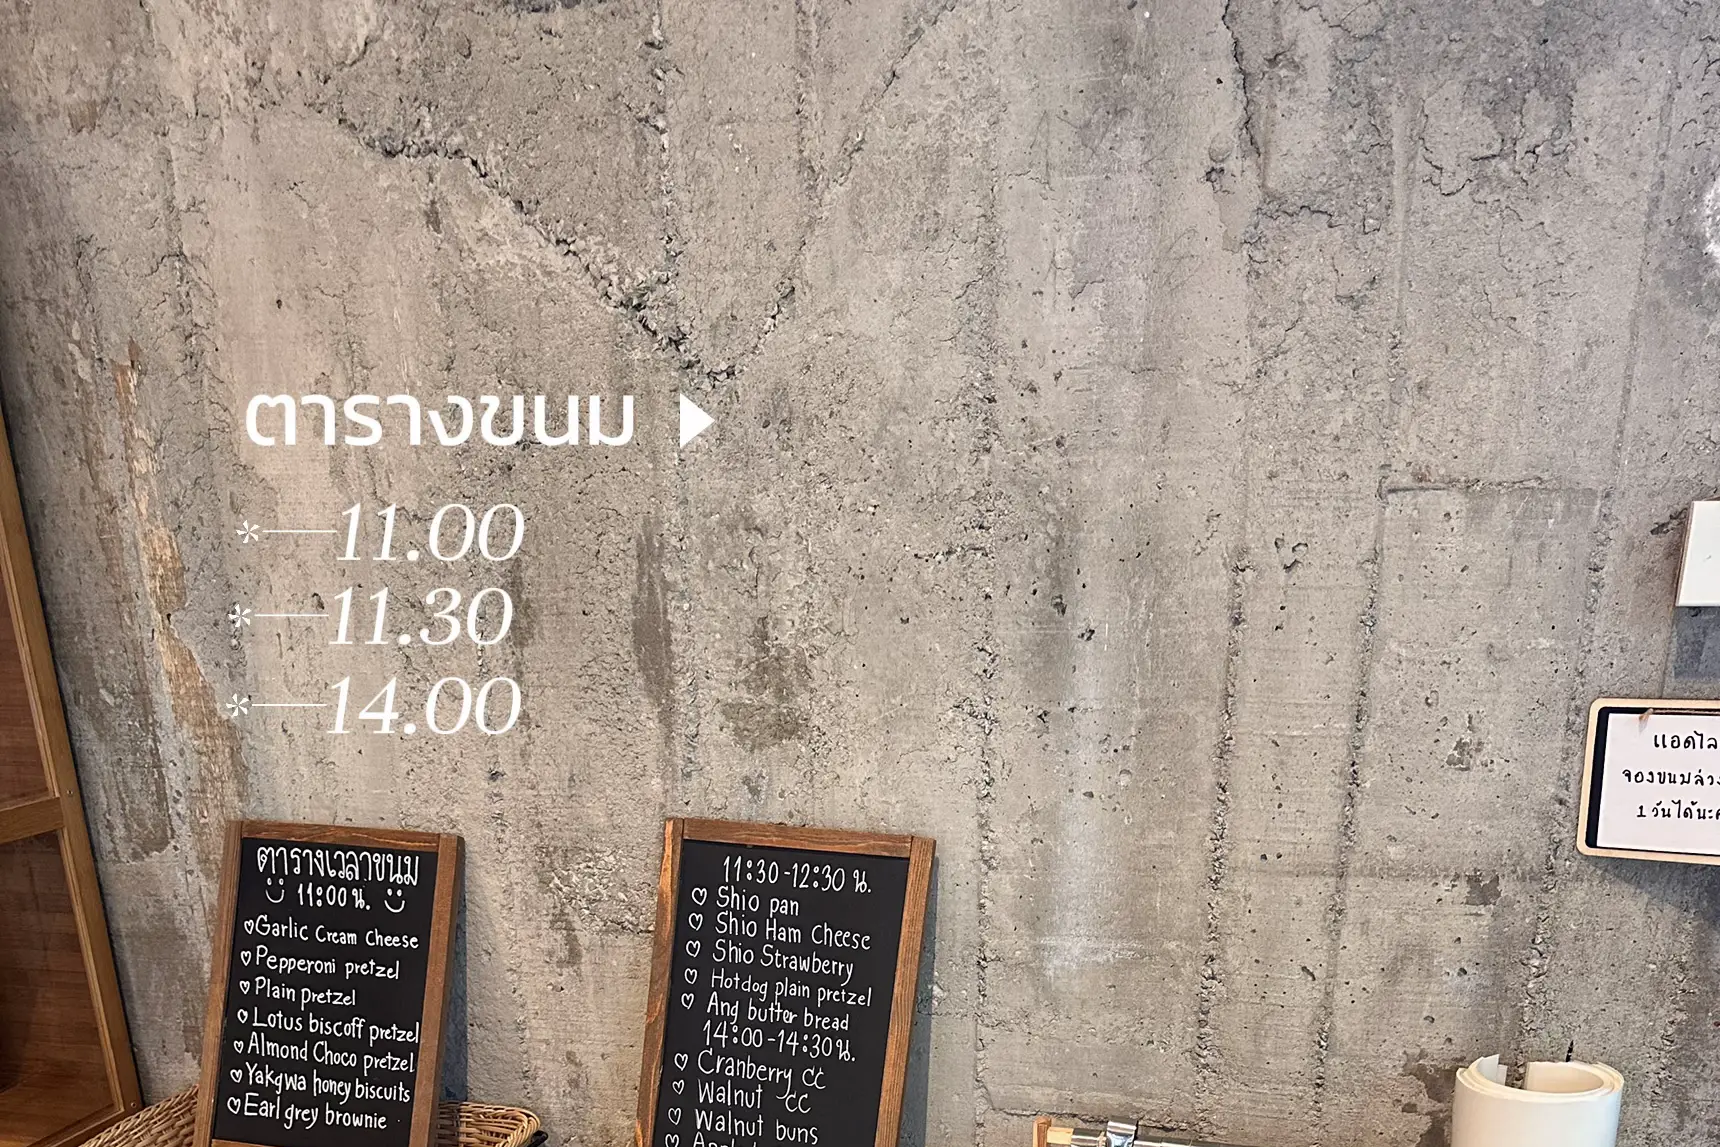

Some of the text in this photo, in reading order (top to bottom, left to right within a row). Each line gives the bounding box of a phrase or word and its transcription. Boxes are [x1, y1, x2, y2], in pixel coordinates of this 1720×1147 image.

[1653, 730, 1719, 750] แอดไล
[257, 845, 419, 886] ตารางเวลาขนม
[297, 884, 371, 911] 11:00 น.
[716, 886, 799, 917] Shio pan
[255, 914, 419, 949] Garlic Cream Cheese
[714, 913, 871, 951] Shio Ham Cheese
[255, 945, 400, 980] Pepperoni pretzel
[712, 939, 854, 986] Shio Strawberry
[254, 976, 356, 1011] Plain pretzel
[706, 991, 849, 1032] Ang butter bread
[774, 980, 810, 1005] plain
[817, 985, 873, 1007] pretzel
[252, 1006, 419, 1047] Lotus biscoff pretzel
[247, 1031, 415, 1077] Almond Choco pretzel
[245, 1061, 410, 1105] Yakgwa honey biscuits
[697, 1048, 792, 1098] Cranberry
[244, 1092, 387, 1130] Earl grey brownie
[697, 1078, 811, 1114] Walnut CC
[695, 1108, 819, 1145] Walnut buns
